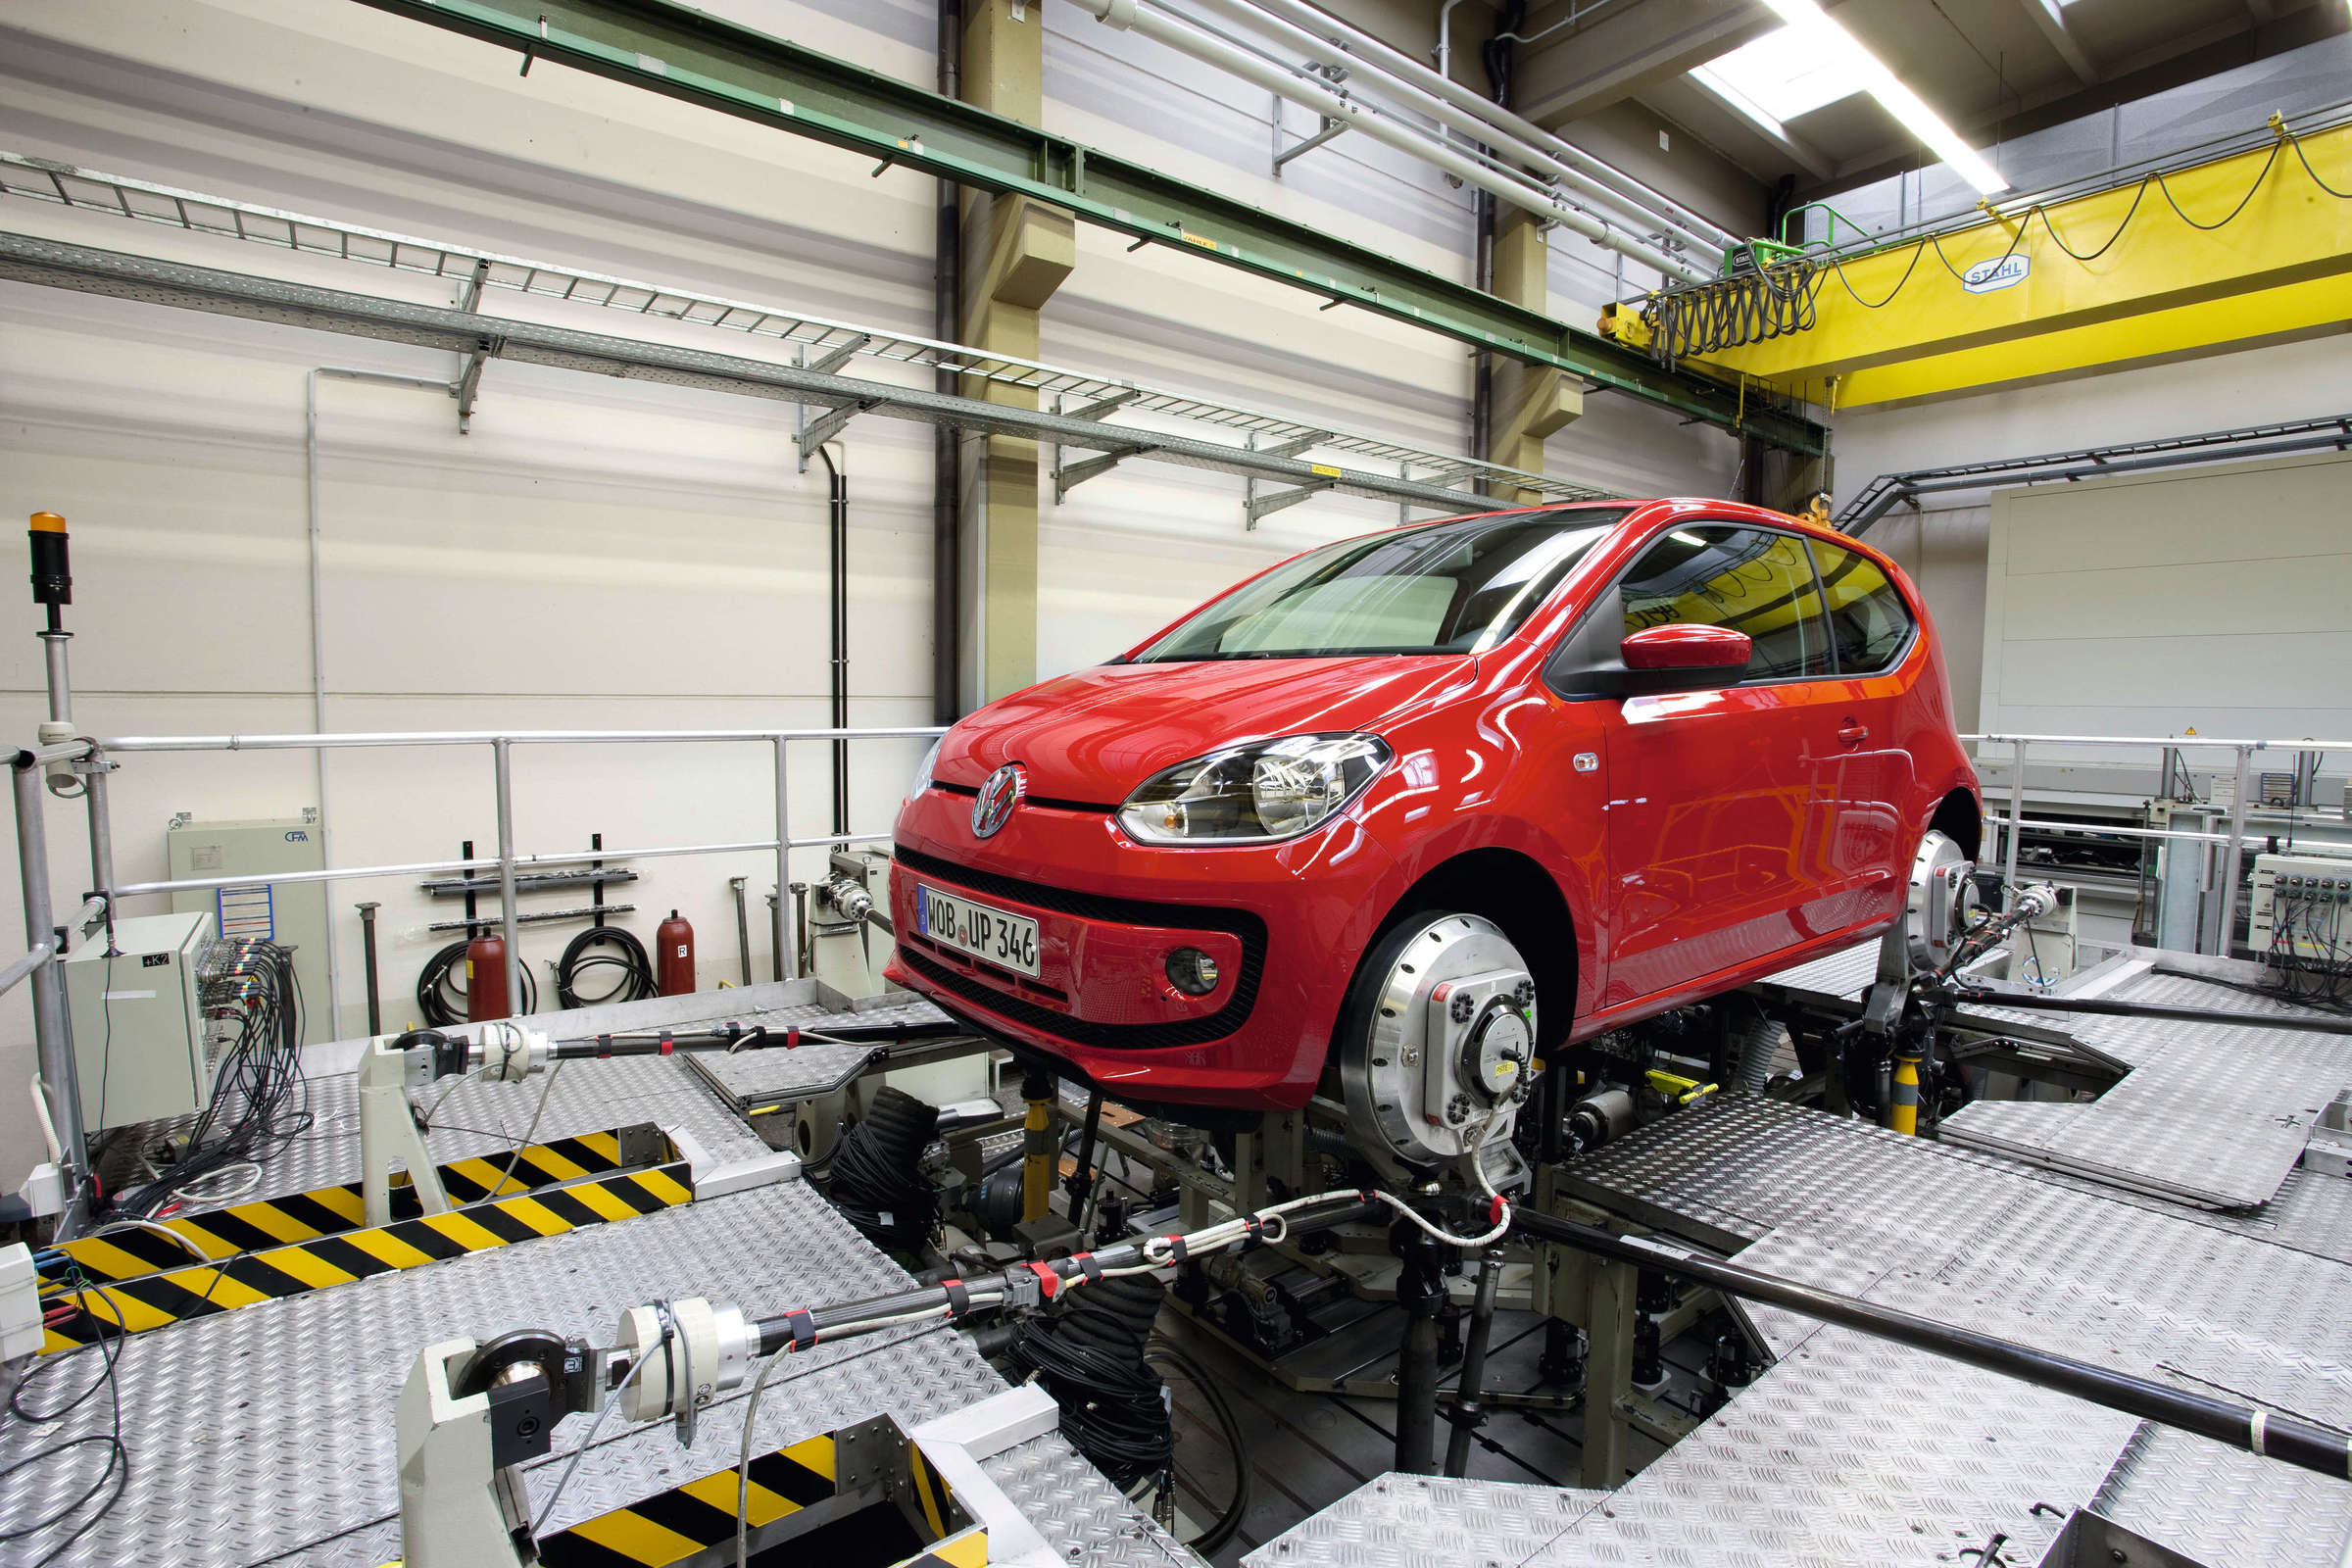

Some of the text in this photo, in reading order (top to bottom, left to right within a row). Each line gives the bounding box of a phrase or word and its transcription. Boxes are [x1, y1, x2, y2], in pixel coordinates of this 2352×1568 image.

[1971, 262, 2023, 284] STAHL
[927, 894, 1036, 968] WOB UP 346
[678, 946, 686, 956] R
[144, 954, 169, 966] +K2
